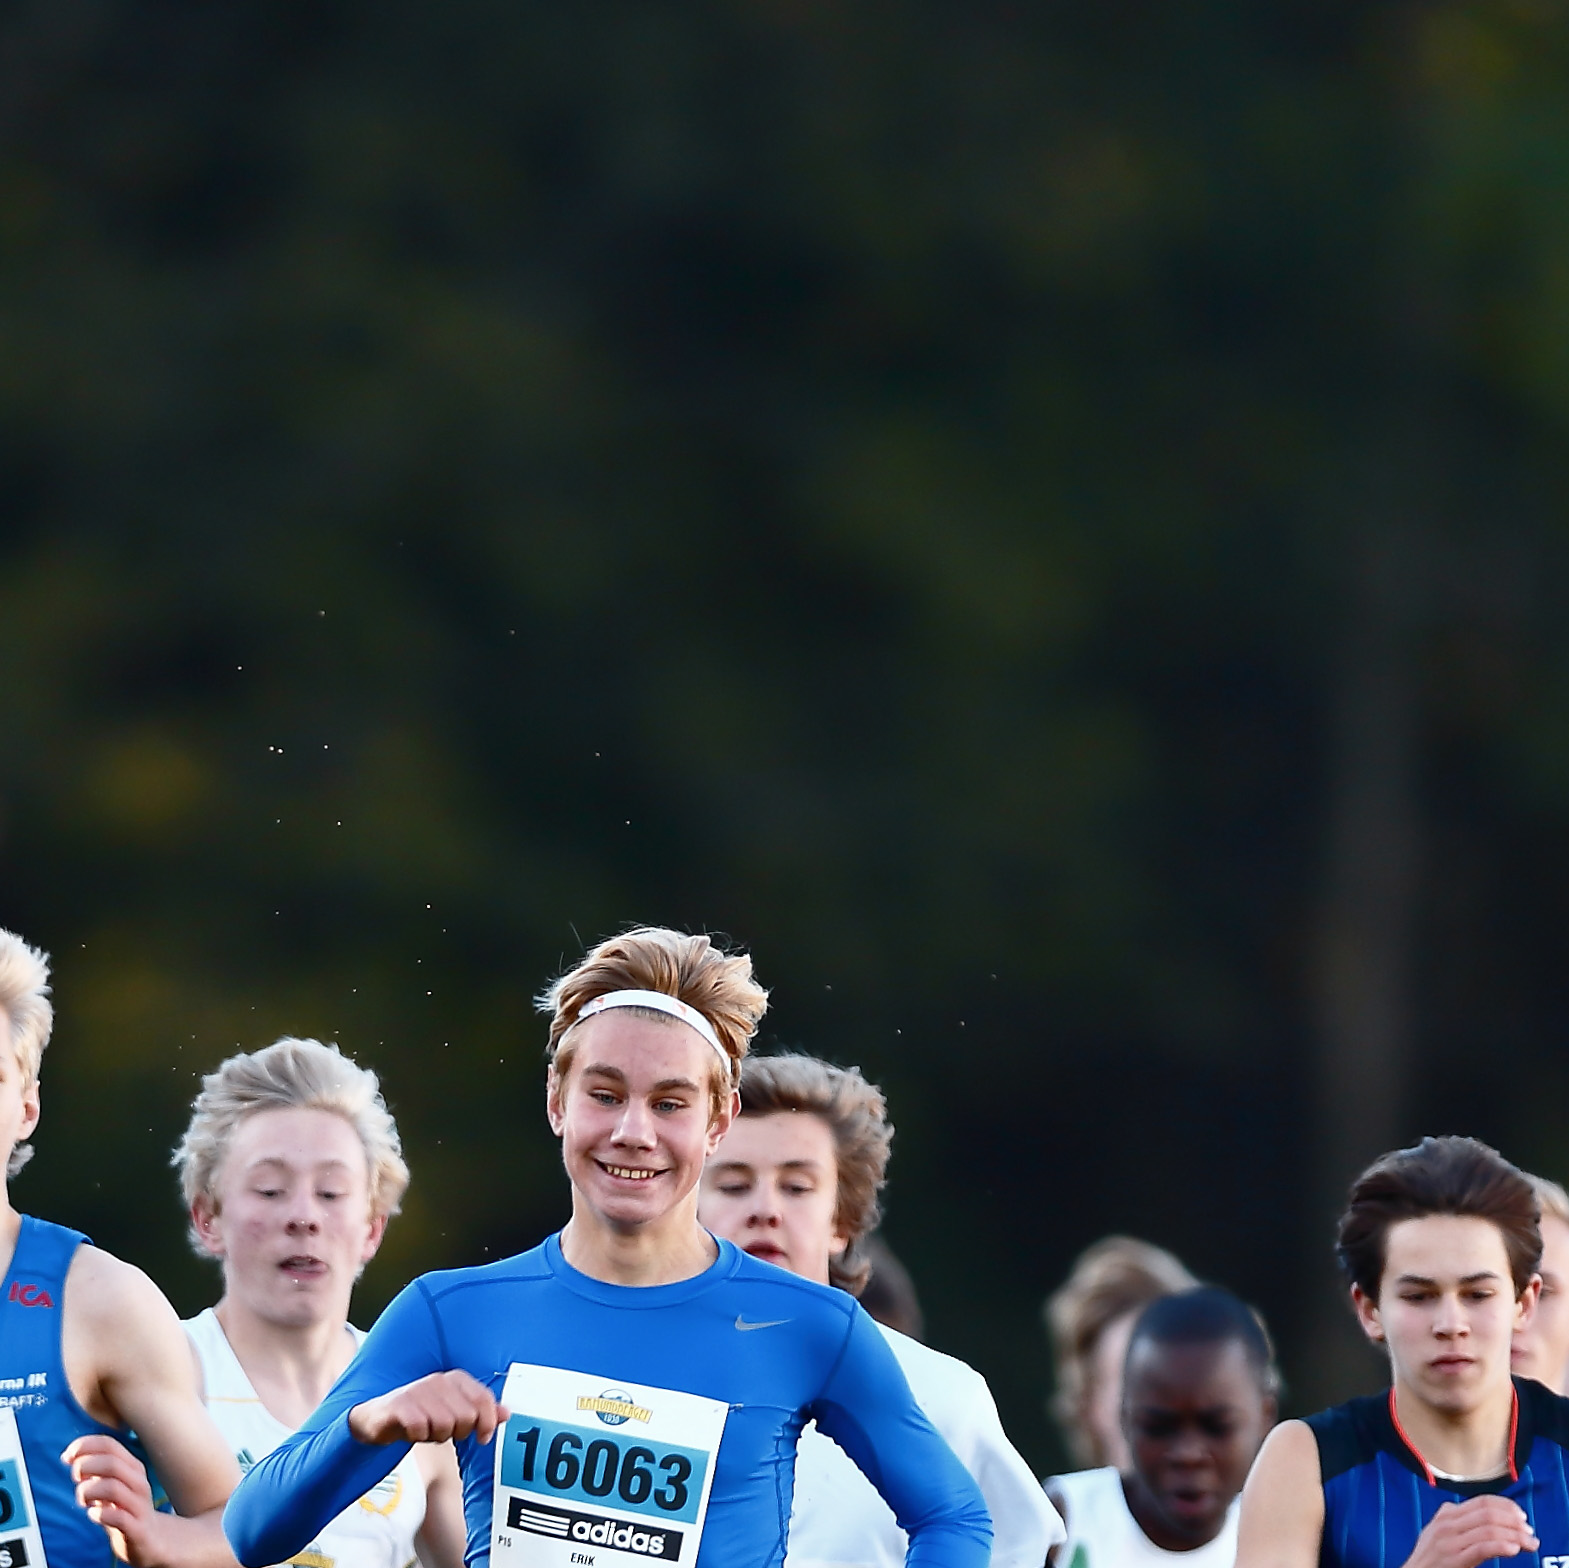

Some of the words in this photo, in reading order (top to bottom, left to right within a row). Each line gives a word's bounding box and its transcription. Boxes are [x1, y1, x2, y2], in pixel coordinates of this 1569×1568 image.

[9, 1281, 54, 1308] ICA
[27, 1372, 48, 1389] IK
[516, 1426, 692, 1512] 16063
[498, 1535, 512, 1548] P15
[572, 1518, 666, 1555] adidas
[570, 1552, 596, 1567] ERIK
